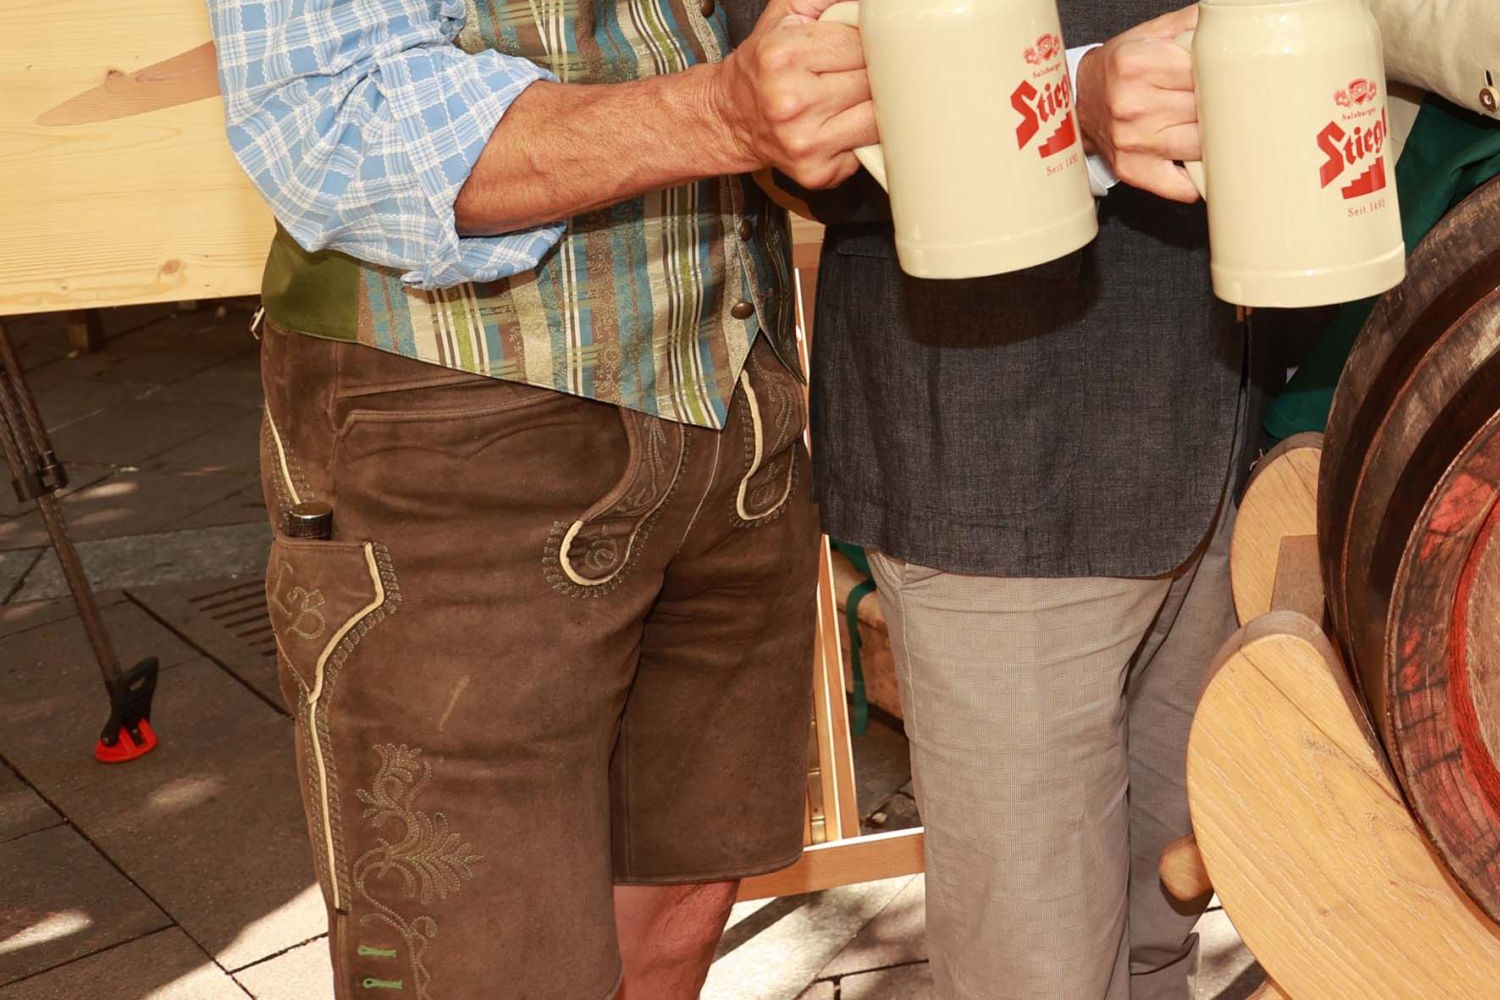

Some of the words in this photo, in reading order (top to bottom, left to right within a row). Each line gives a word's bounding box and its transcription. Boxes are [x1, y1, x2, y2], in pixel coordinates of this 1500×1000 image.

[1010, 74, 1070, 150] Stieg
[1316, 106, 1387, 189] Stiegl
[1348, 204, 1366, 217] Seit
